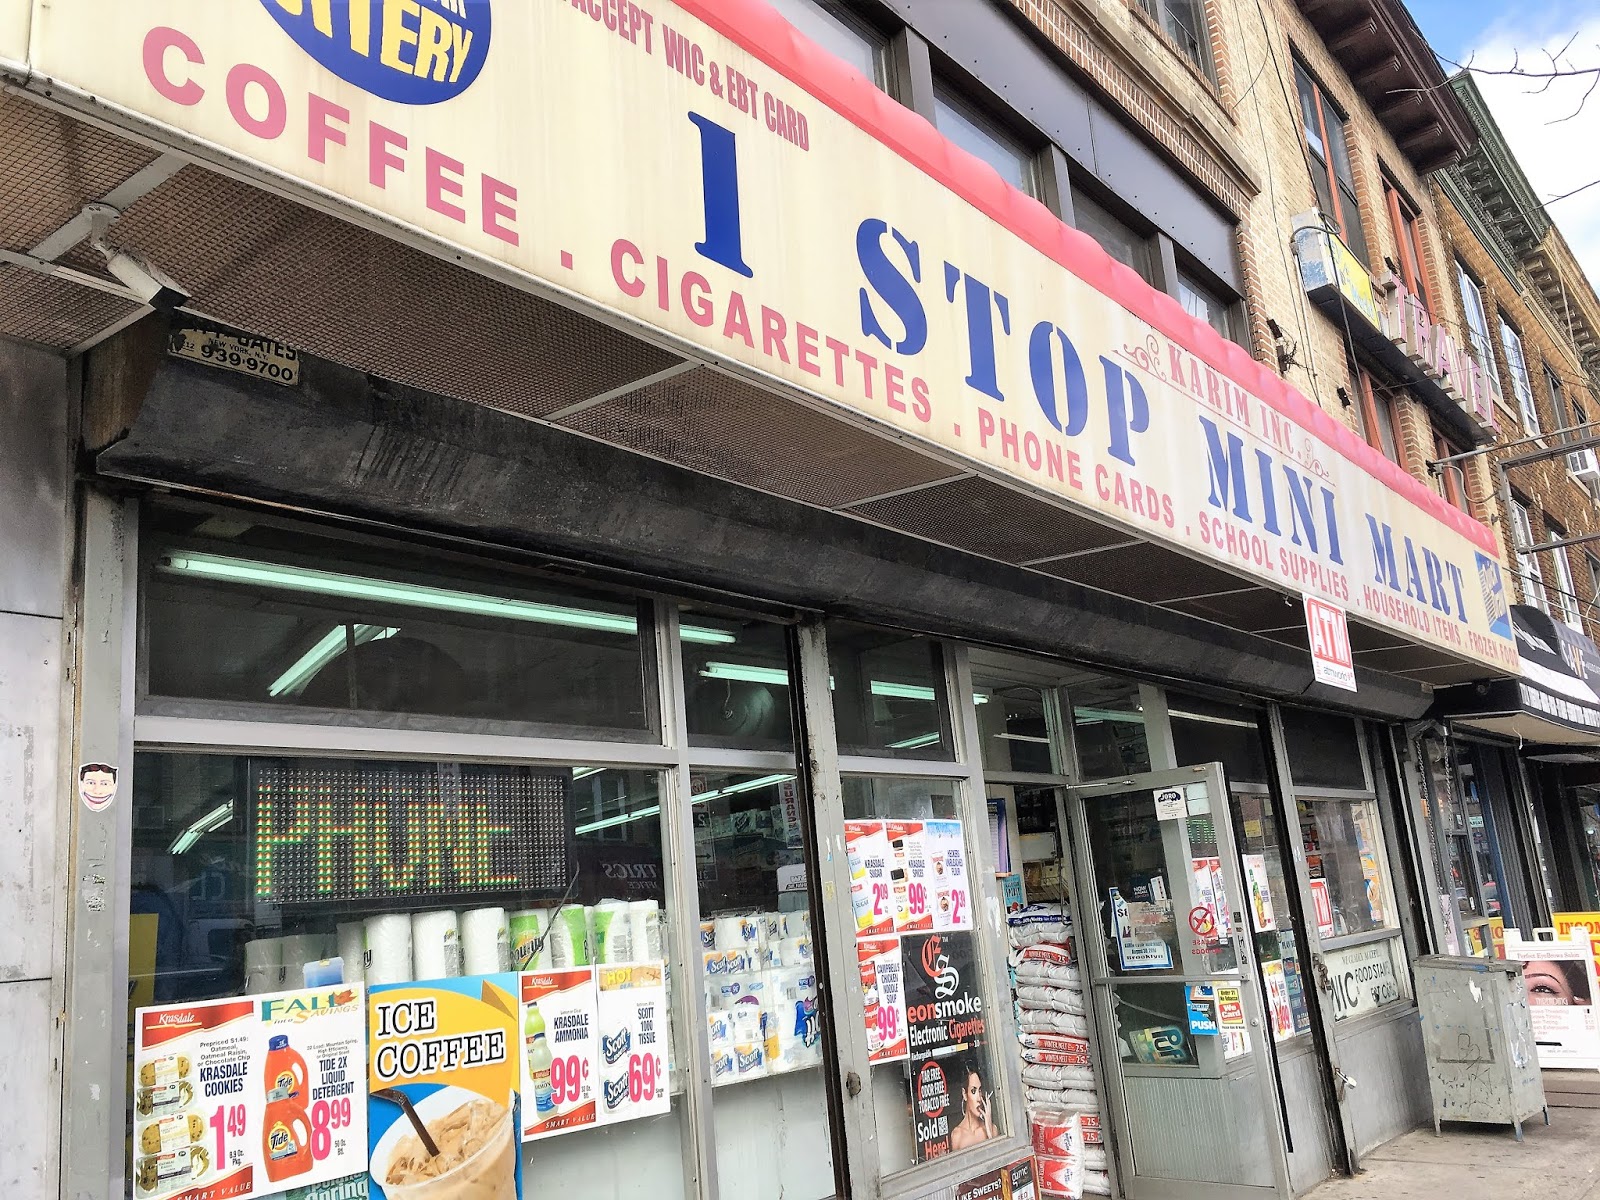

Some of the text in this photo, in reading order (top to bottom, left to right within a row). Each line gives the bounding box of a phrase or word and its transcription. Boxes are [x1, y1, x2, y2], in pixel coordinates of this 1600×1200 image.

[662, 23, 705, 86] WIC
[709, 61, 723, 99] &
[726, 65, 758, 120] EBT
[764, 91, 809, 151] CARD
[143, 27, 519, 247] COFFEE
[610, 238, 931, 423] CIGARETTES
[1167, 342, 1302, 460] KARIM INC.
[856, 218, 1149, 466] STOP
[1199, 415, 1344, 566] MINI
[1365, 513, 1468, 624] MART
[979, 407, 1175, 528] PHONE CARDS
[1200, 511, 1349, 602] SCHOOL SUPPLIES
[1363, 585, 1461, 646] HOUSEHOLD ITEMS
[1312, 602, 1350, 664] ATM
[1468, 630, 1499, 660] FROZEN
[531, 976, 553, 986] Krasdale
[606, 967, 633, 986] HOT
[1355, 966, 1373, 983] FOOD
[293, 1004, 360, 1024] SAVINGS
[638, 1007, 654, 1019] SCOTT
[908, 992, 982, 1023] eonsmoke
[1222, 1010, 1241, 1018] Card
[158, 1012, 195, 1025] Krasdale
[378, 1001, 436, 1037] ICE
[554, 1014, 589, 1029] KRASDALE
[640, 1020, 653, 1032] 1000
[1191, 1021, 1216, 1030] PUSH
[555, 1027, 589, 1043] AMMONIA
[638, 1032, 656, 1045] TISSUE
[910, 1022, 949, 1047] Electronic
[948, 1016, 985, 1043] Cigarettes
[606, 1027, 628, 1057] Scott
[205, 1056, 236, 1066] Chocolate
[319, 1056, 347, 1072] TIDE 2X
[377, 1032, 504, 1077] COFFEE
[738, 1048, 760, 1068] Scott
[200, 1062, 248, 1082] KRASDALE
[322, 1070, 345, 1085] LIQUID
[205, 1078, 243, 1097] COOKIES
[277, 1076, 293, 1089] Tide
[313, 1081, 354, 1100] DETERGENT
[607, 1071, 629, 1102] Scott
[546, 1113, 596, 1129] SMART VALUE
[917, 1119, 938, 1142] Sold
[271, 1132, 288, 1150] Tide
[925, 1136, 950, 1160] Here!
[221, 1181, 252, 1196] VALUE
[973, 1178, 1002, 1198] SWEETS?
